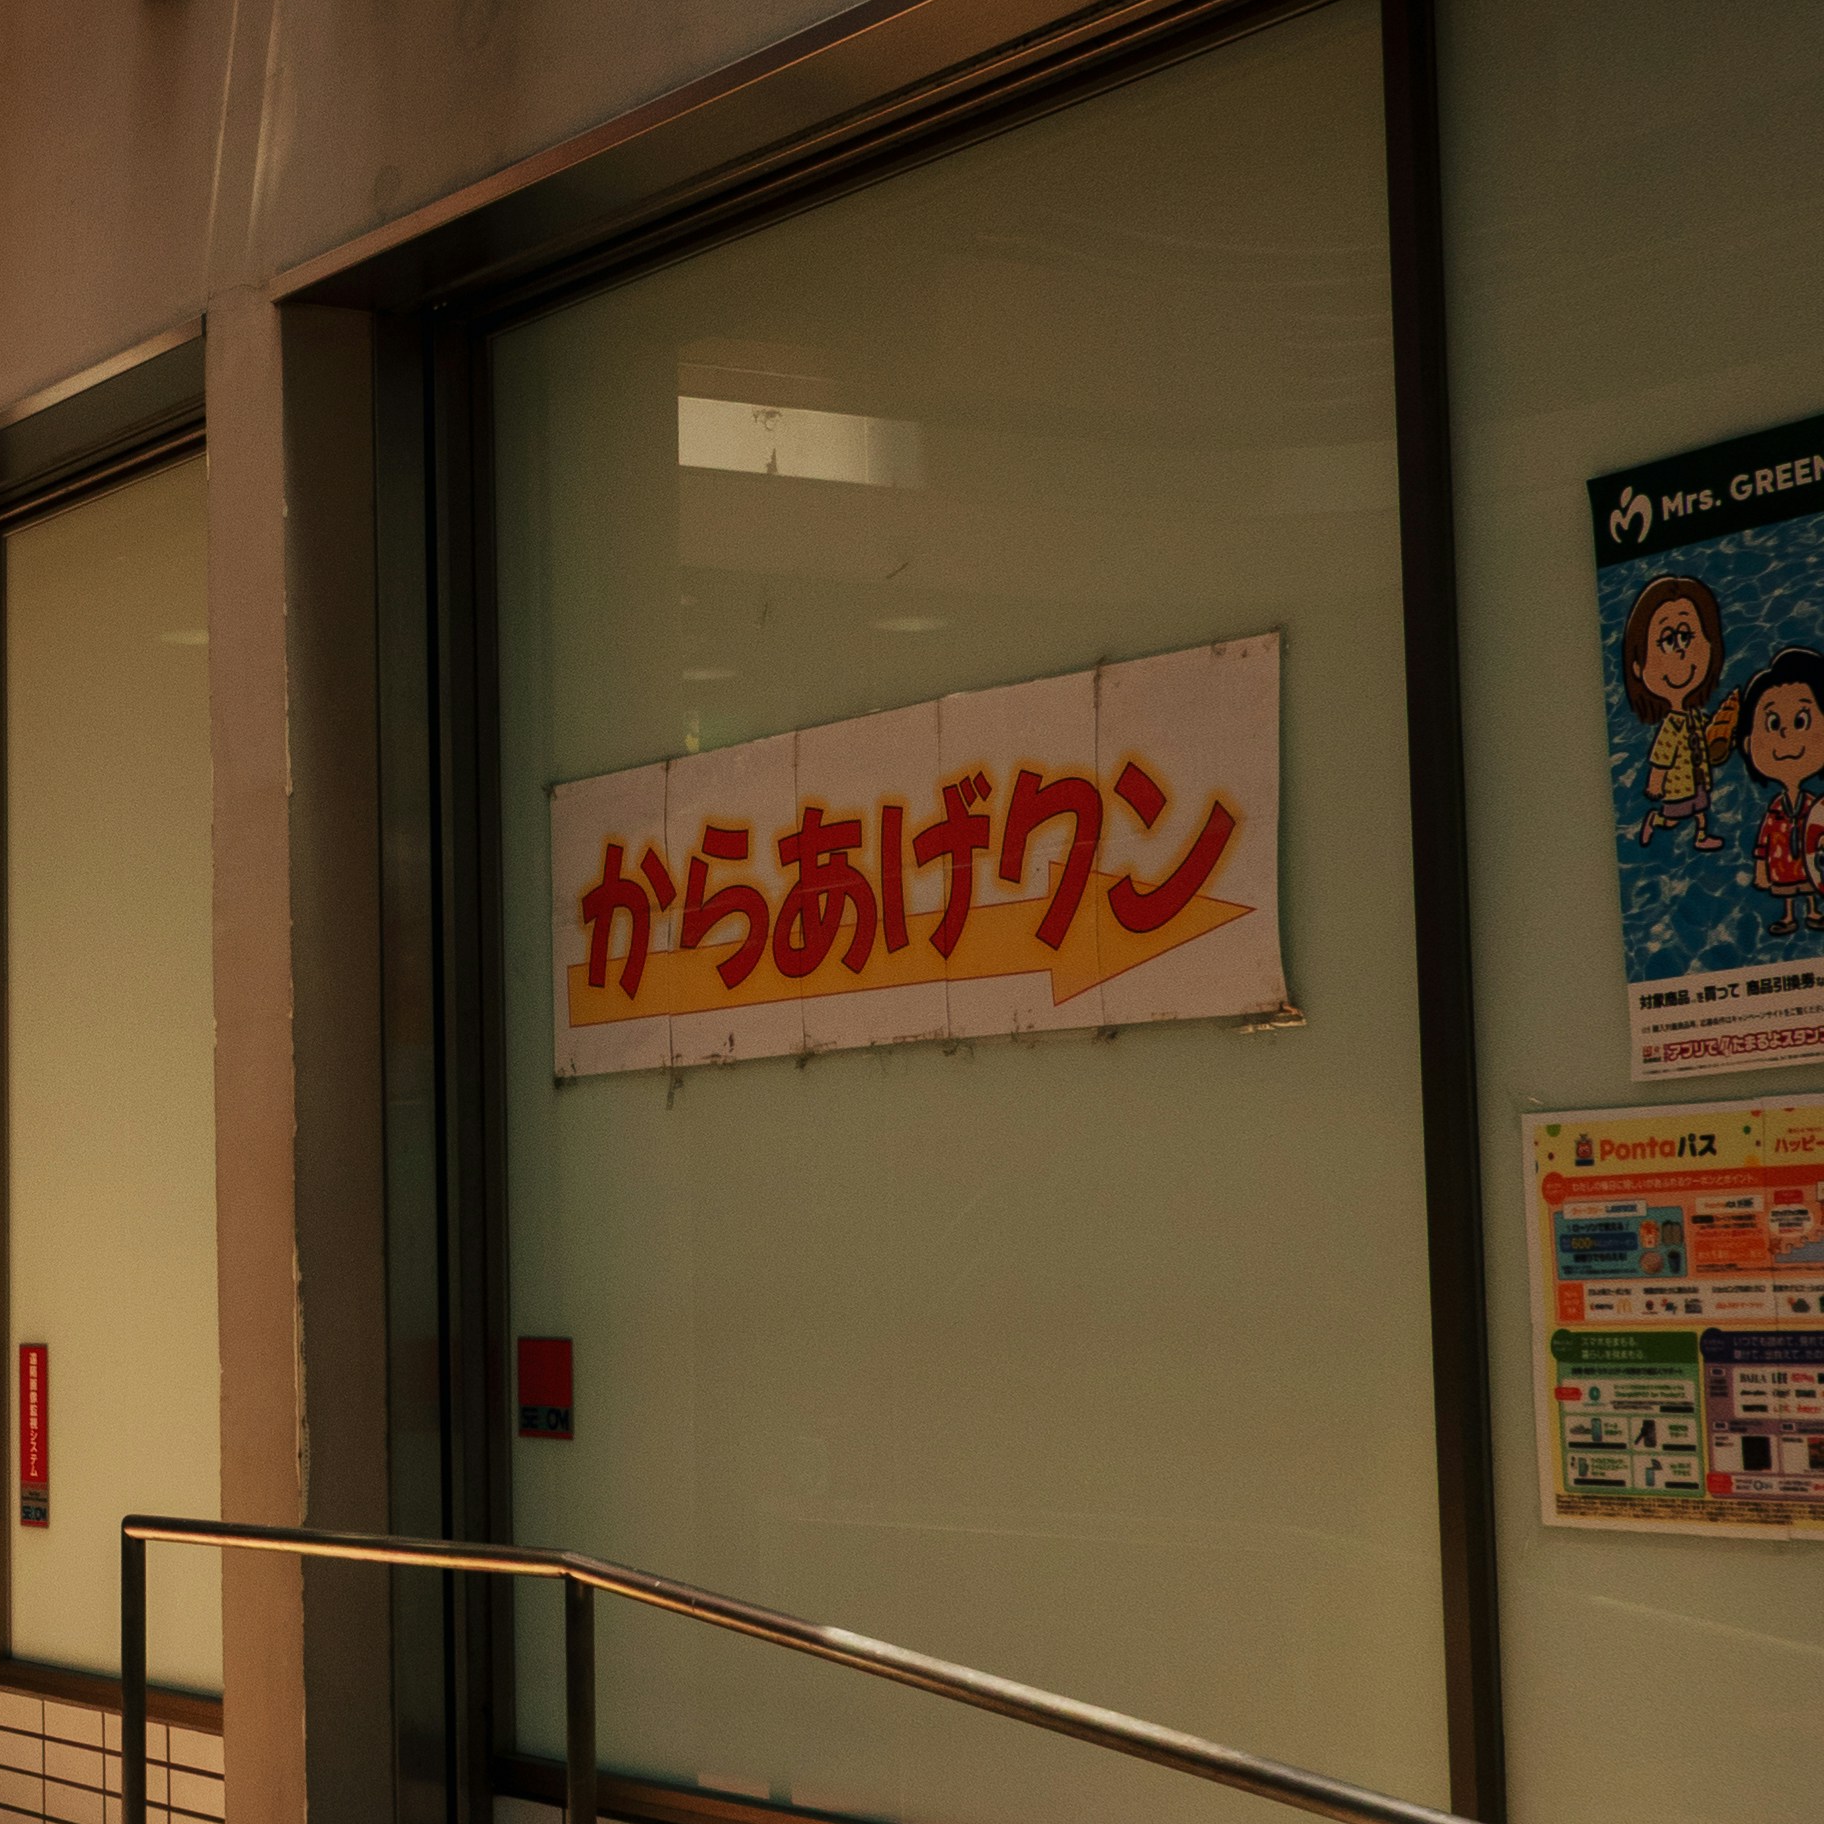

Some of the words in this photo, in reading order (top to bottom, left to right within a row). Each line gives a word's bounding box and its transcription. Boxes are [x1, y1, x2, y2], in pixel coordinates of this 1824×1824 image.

[1661, 488, 1721, 522] Mrs.
[580, 760, 1237, 1000] からあげクン
[1599, 1133, 1716, 1161] Pontaパス
